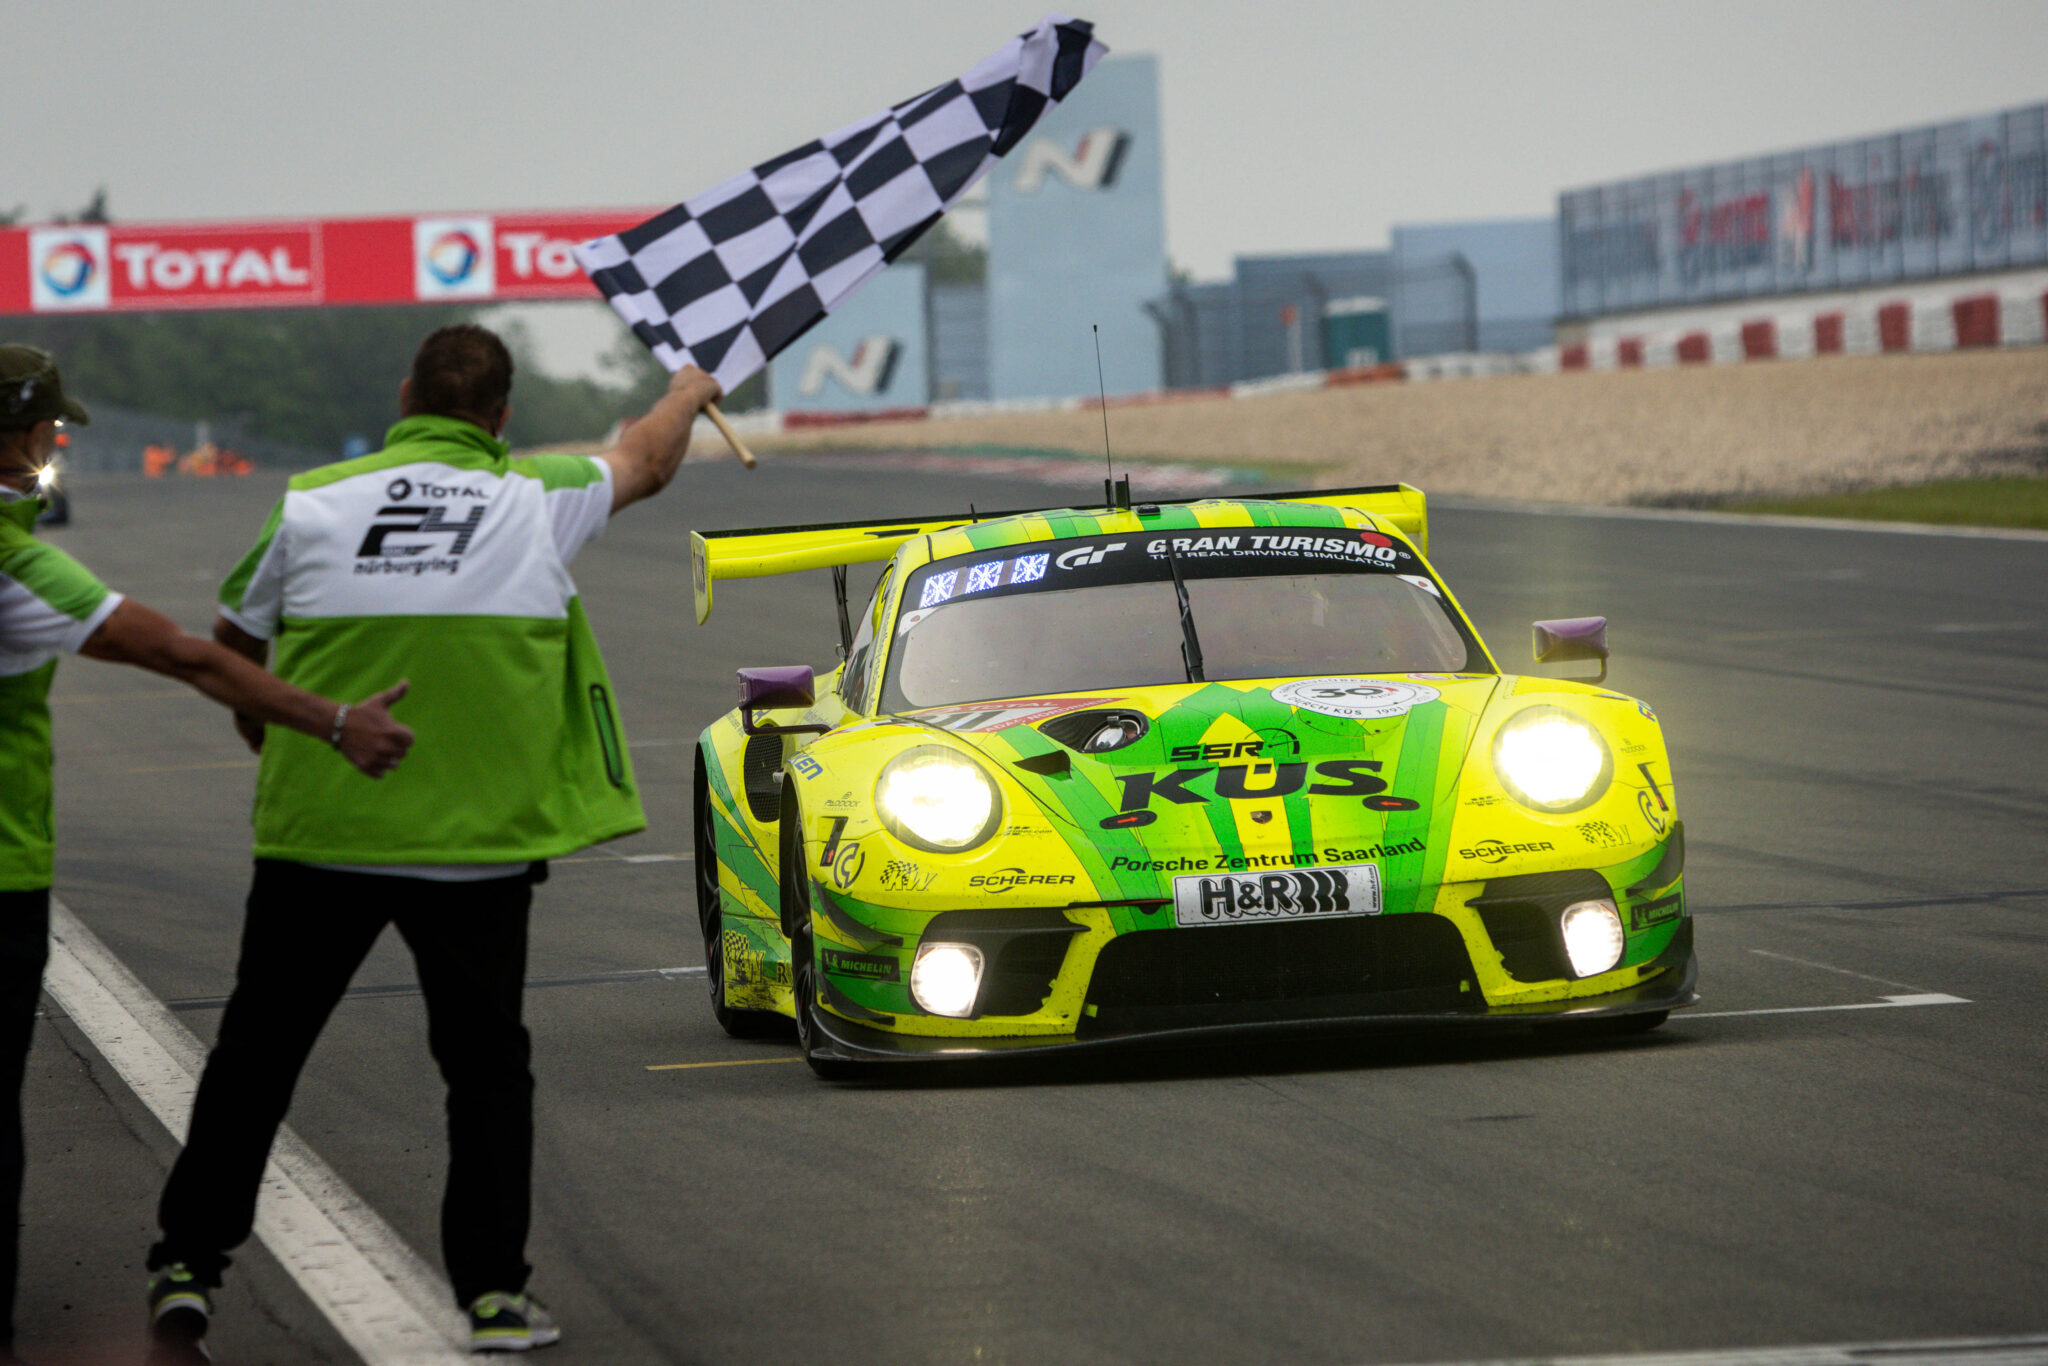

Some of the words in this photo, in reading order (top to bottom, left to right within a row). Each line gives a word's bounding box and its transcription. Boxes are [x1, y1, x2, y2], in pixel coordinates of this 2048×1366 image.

[114, 242, 308, 289] TOTAL
[417, 483, 490, 499] TOTAL
[1146, 536, 1241, 553] GRAN
[1250, 536, 1397, 562] TURISMO
[354, 559, 459, 575] nürburgring
[1303, 552, 1396, 570] SIMULATOR
[1169, 740, 1265, 763] SSR
[1110, 856, 1208, 872] Porsche
[1215, 850, 1318, 870] Zentrum
[1324, 837, 1426, 863] Saarland
[1459, 841, 1555, 860] SCHERER
[969, 874, 1075, 888] SCHERER
[841, 960, 893, 974] MICHELIN
